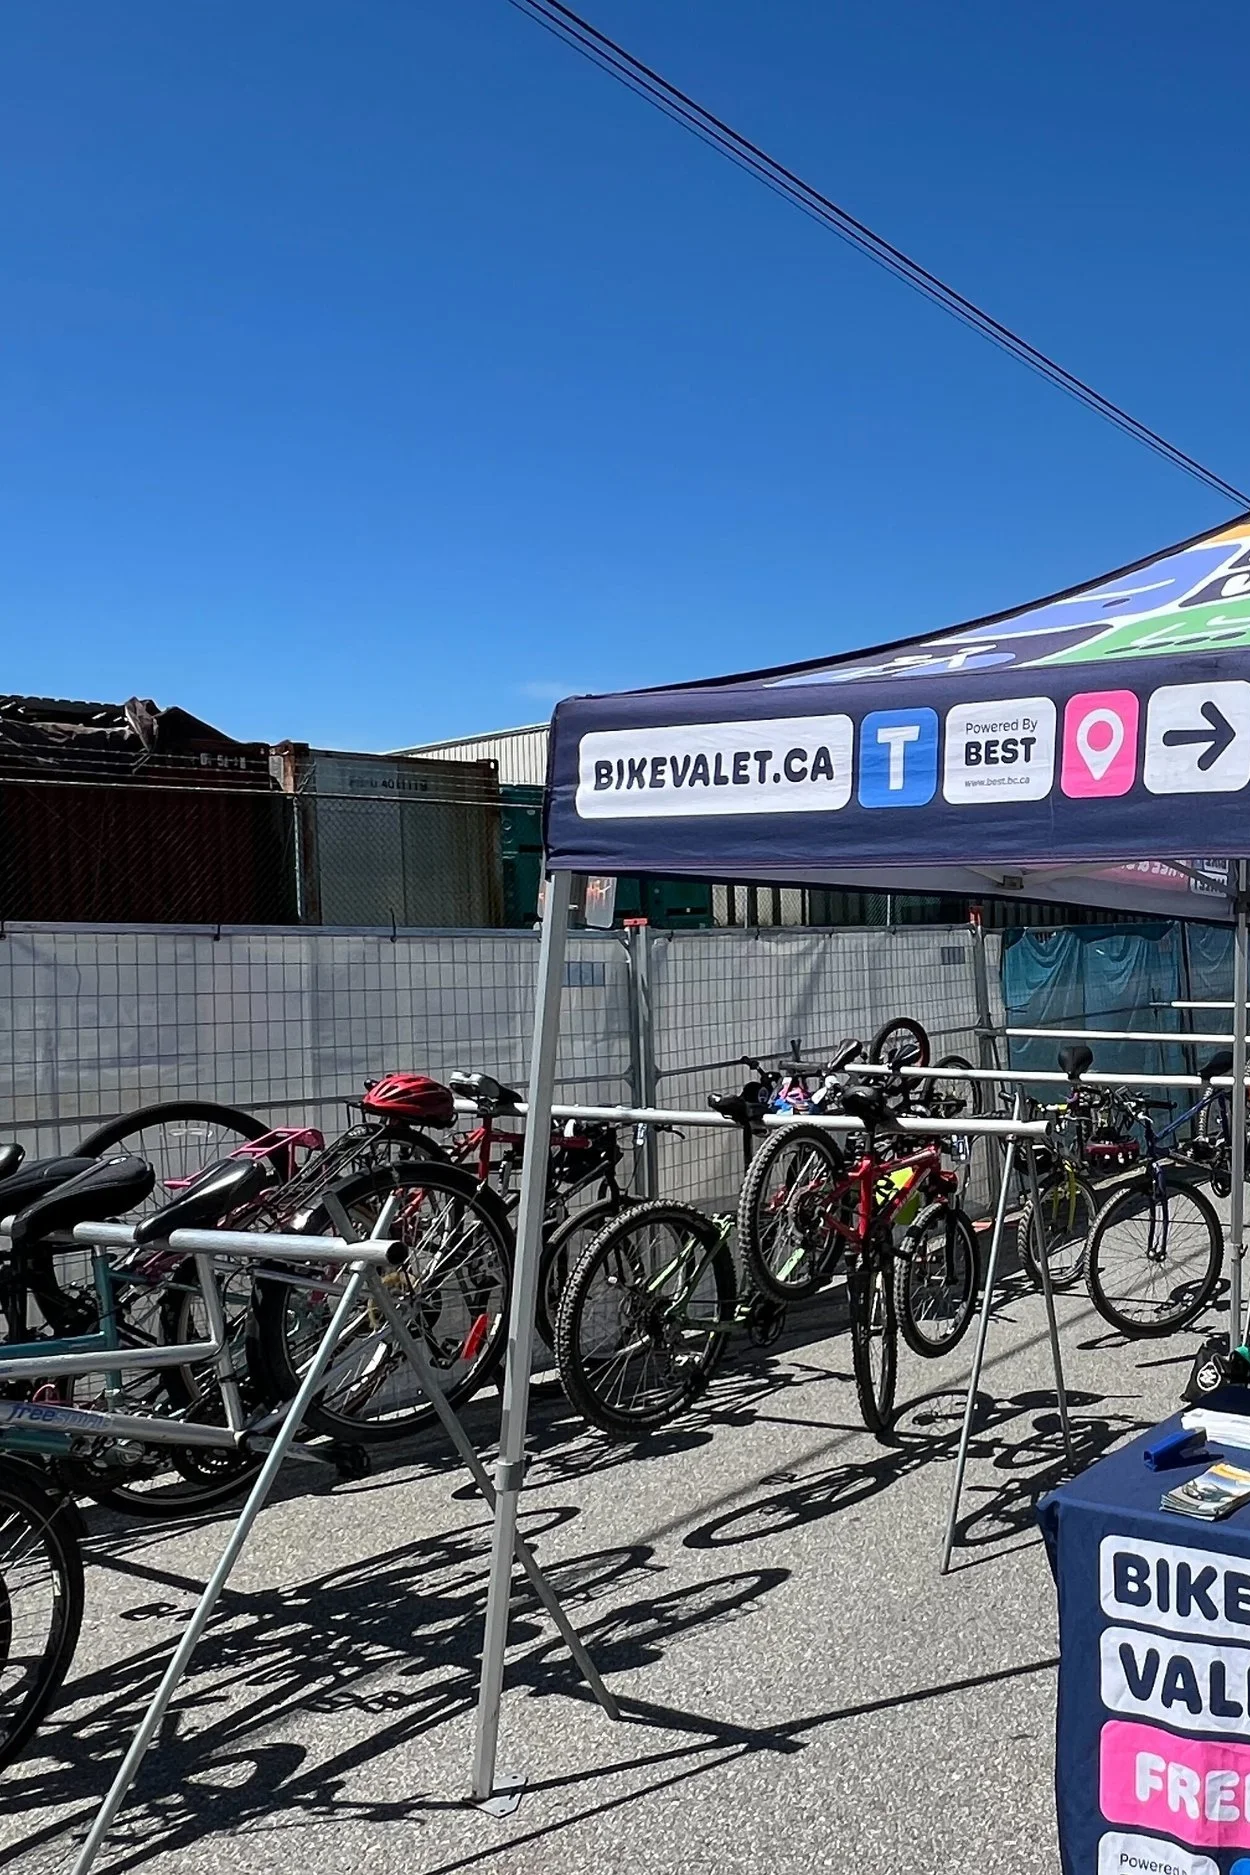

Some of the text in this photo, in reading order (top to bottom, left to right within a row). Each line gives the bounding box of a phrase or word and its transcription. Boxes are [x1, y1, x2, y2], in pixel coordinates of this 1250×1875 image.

[966, 718, 1037, 734] Powered By
[877, 726, 919, 789] T
[965, 737, 1036, 766] BEST
[594, 746, 833, 791] BIKEVALET.CA
[965, 776, 1030, 787] www.best.bc.ca
